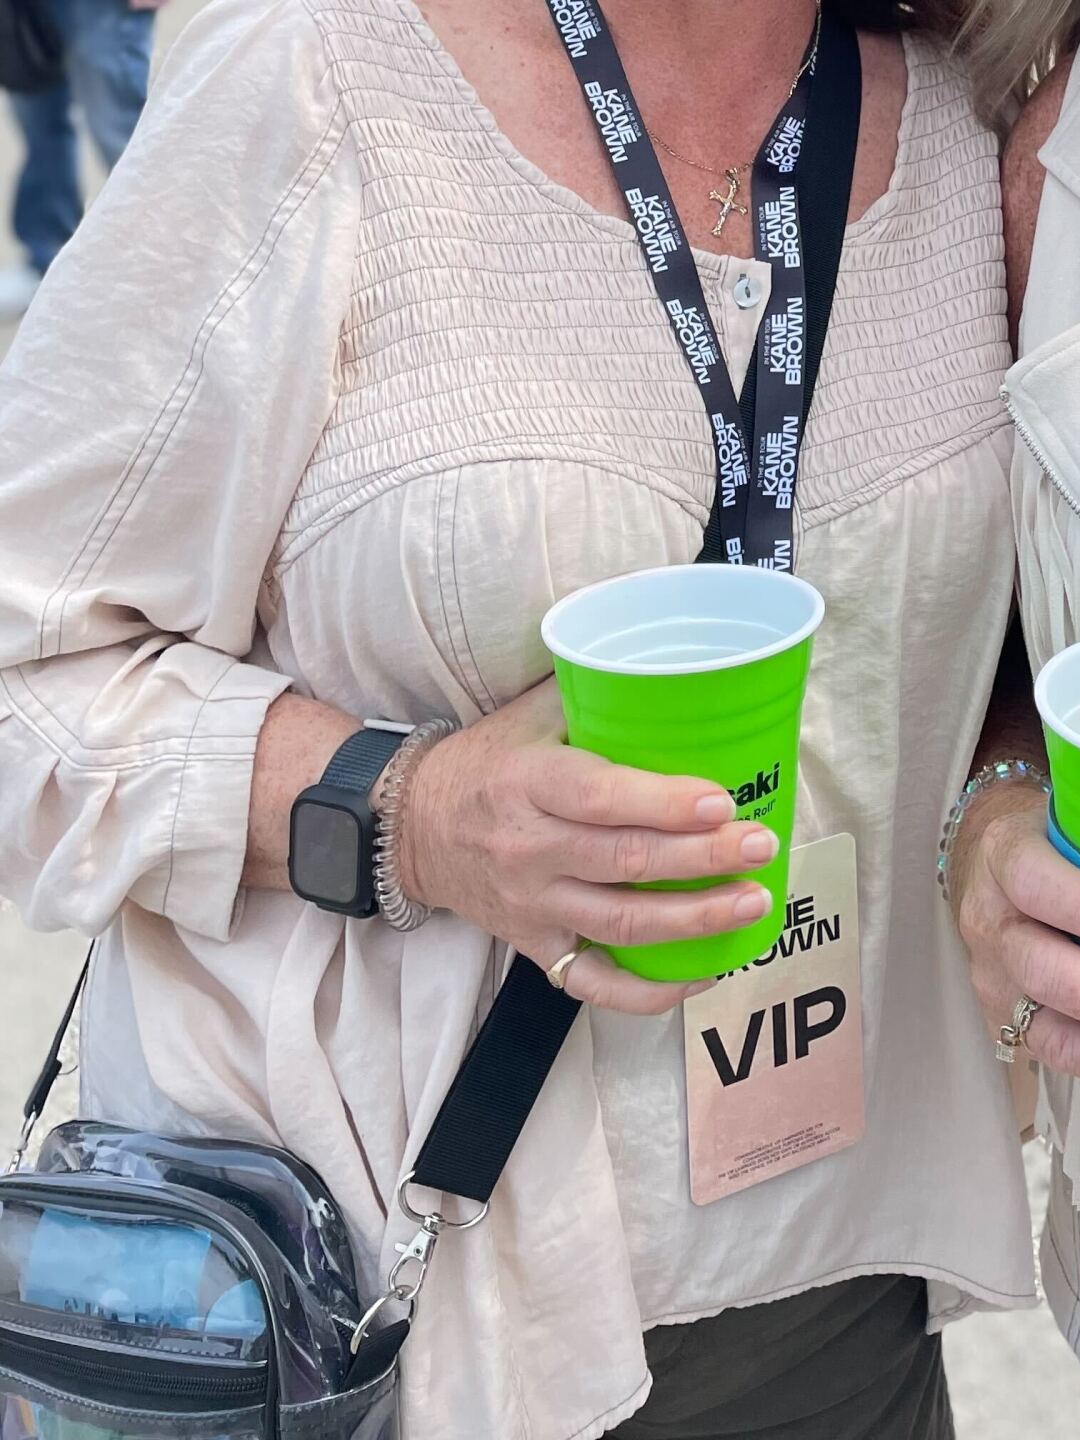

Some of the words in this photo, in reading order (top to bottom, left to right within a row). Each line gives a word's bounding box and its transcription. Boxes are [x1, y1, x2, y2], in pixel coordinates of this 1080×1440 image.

[584, 81, 628, 163] BROWN
[603, 88, 638, 144] KANE
[766, 116, 801, 166] KANE
[779, 118, 806, 173] BRO
[625, 187, 669, 273] BROWN
[644, 195, 678, 254] KANE
[764, 201, 784, 258] KANE
[779, 186, 800, 268] BROWN
[666, 299, 711, 385] BROWN
[683, 307, 716, 366] KANE
[770, 313, 787, 373] KANE
[785, 297, 803, 385] BROWN
[712, 413, 736, 508] BROWN
[725, 422, 748, 487] KANE
[762, 432, 783, 496] KANE
[775, 416, 799, 509] BROWN
[716, 914, 840, 981] OWN
[700, 985, 847, 1088] VIP
